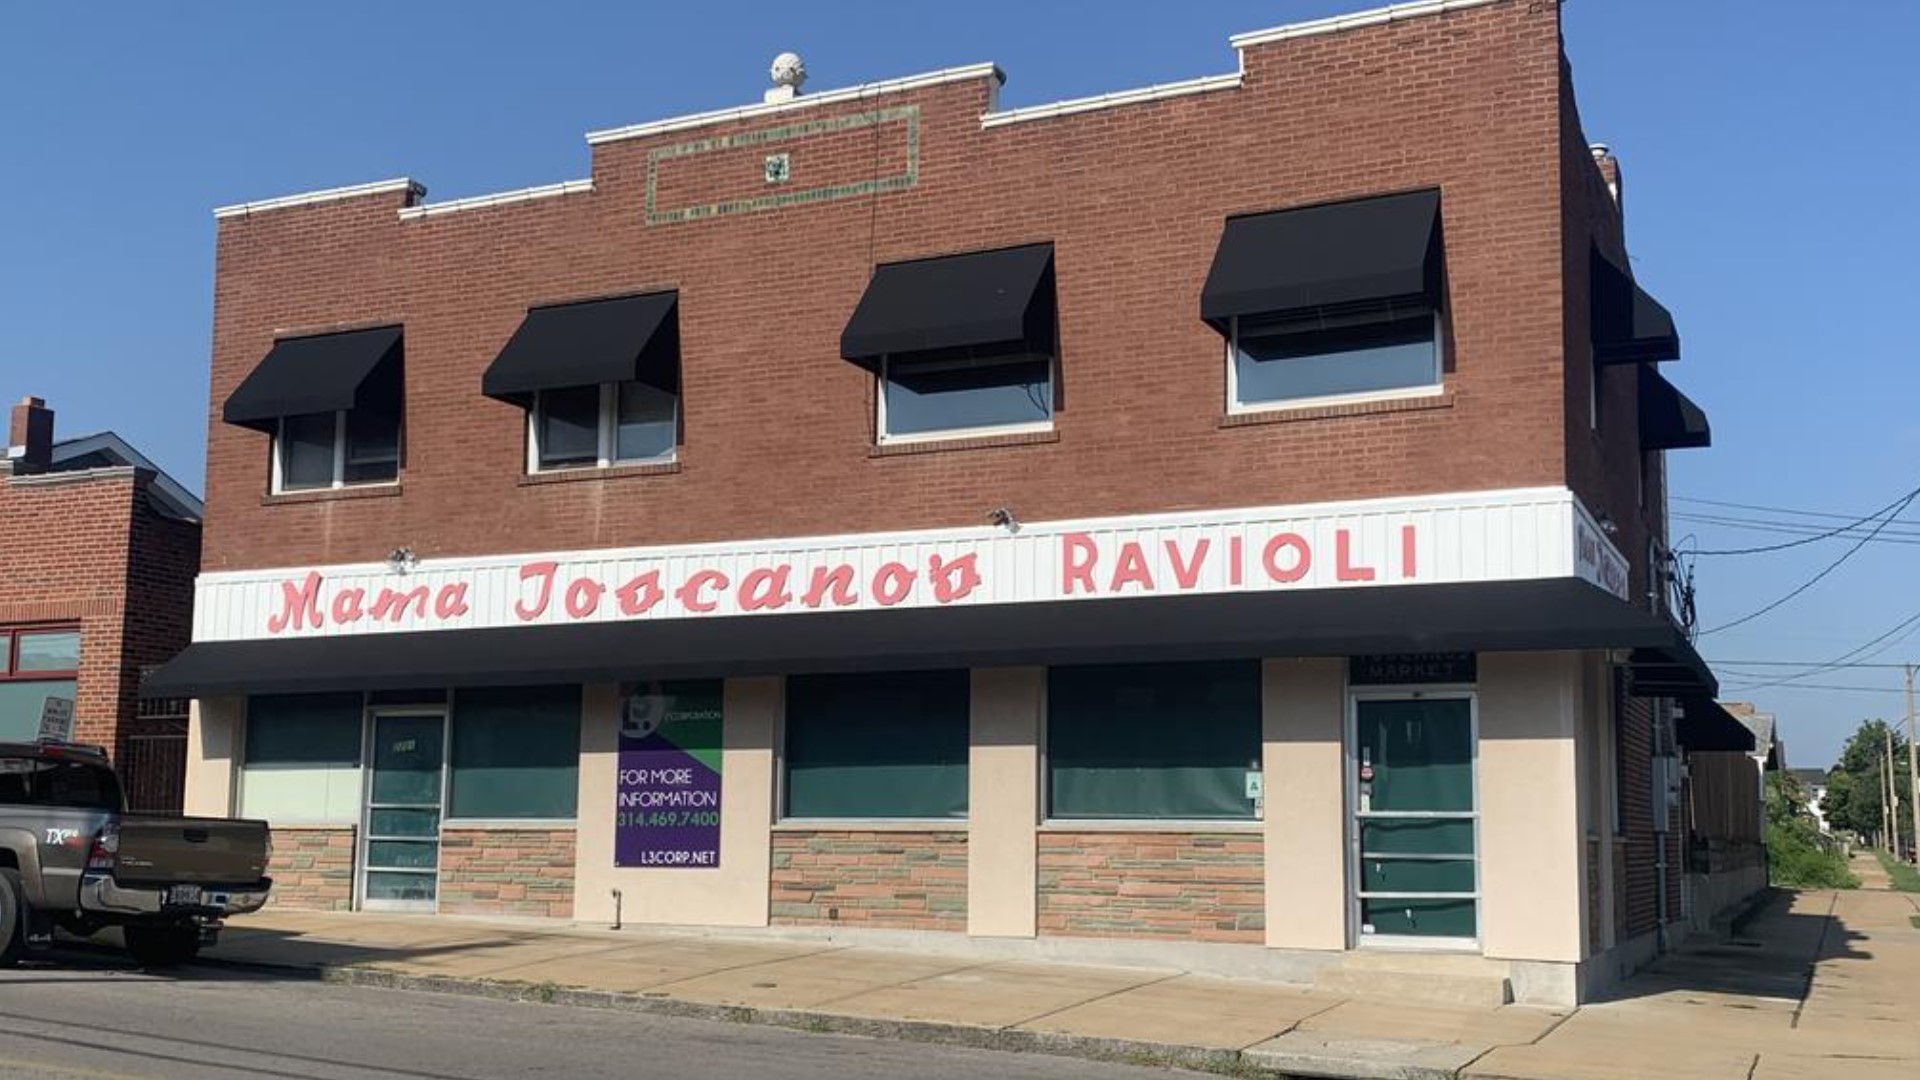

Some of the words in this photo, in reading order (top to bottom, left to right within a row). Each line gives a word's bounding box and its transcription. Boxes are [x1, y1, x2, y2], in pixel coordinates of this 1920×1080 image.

[267, 570, 470, 634] Mama
[1062, 524, 1416, 595] RAVIOLI
[619, 768, 648, 785] FOR
[651, 768, 693, 785] MORE
[618, 790, 718, 807] INFORMATION
[617, 811, 719, 827] 314.469.7400
[641, 850, 717, 865] L3CORP.NET
